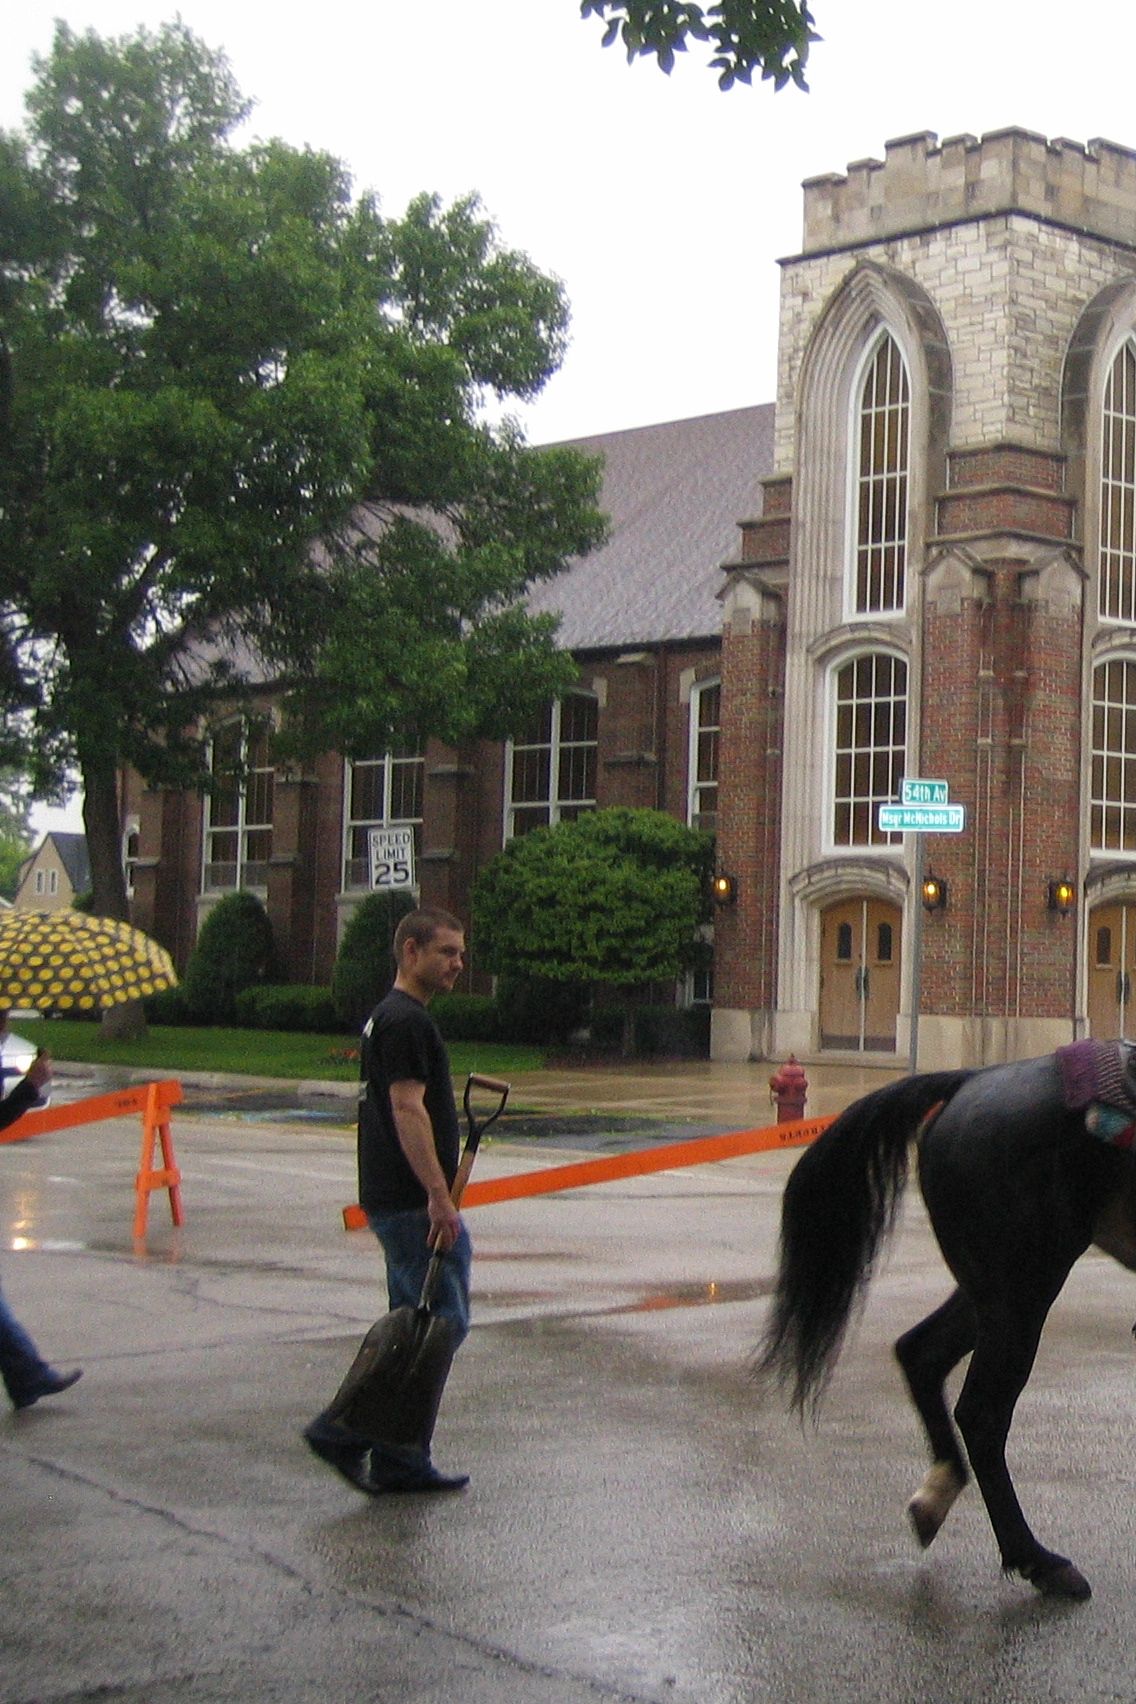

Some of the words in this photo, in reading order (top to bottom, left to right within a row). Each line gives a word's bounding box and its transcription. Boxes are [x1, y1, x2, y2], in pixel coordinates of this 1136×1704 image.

[905, 784, 931, 801] 54th
[934, 785, 946, 802] Av
[882, 811, 902, 828] Msgr
[949, 811, 961, 825] Dr
[372, 832, 410, 848] SPEED
[375, 848, 406, 861] LIMIT
[374, 861, 410, 885] 25
